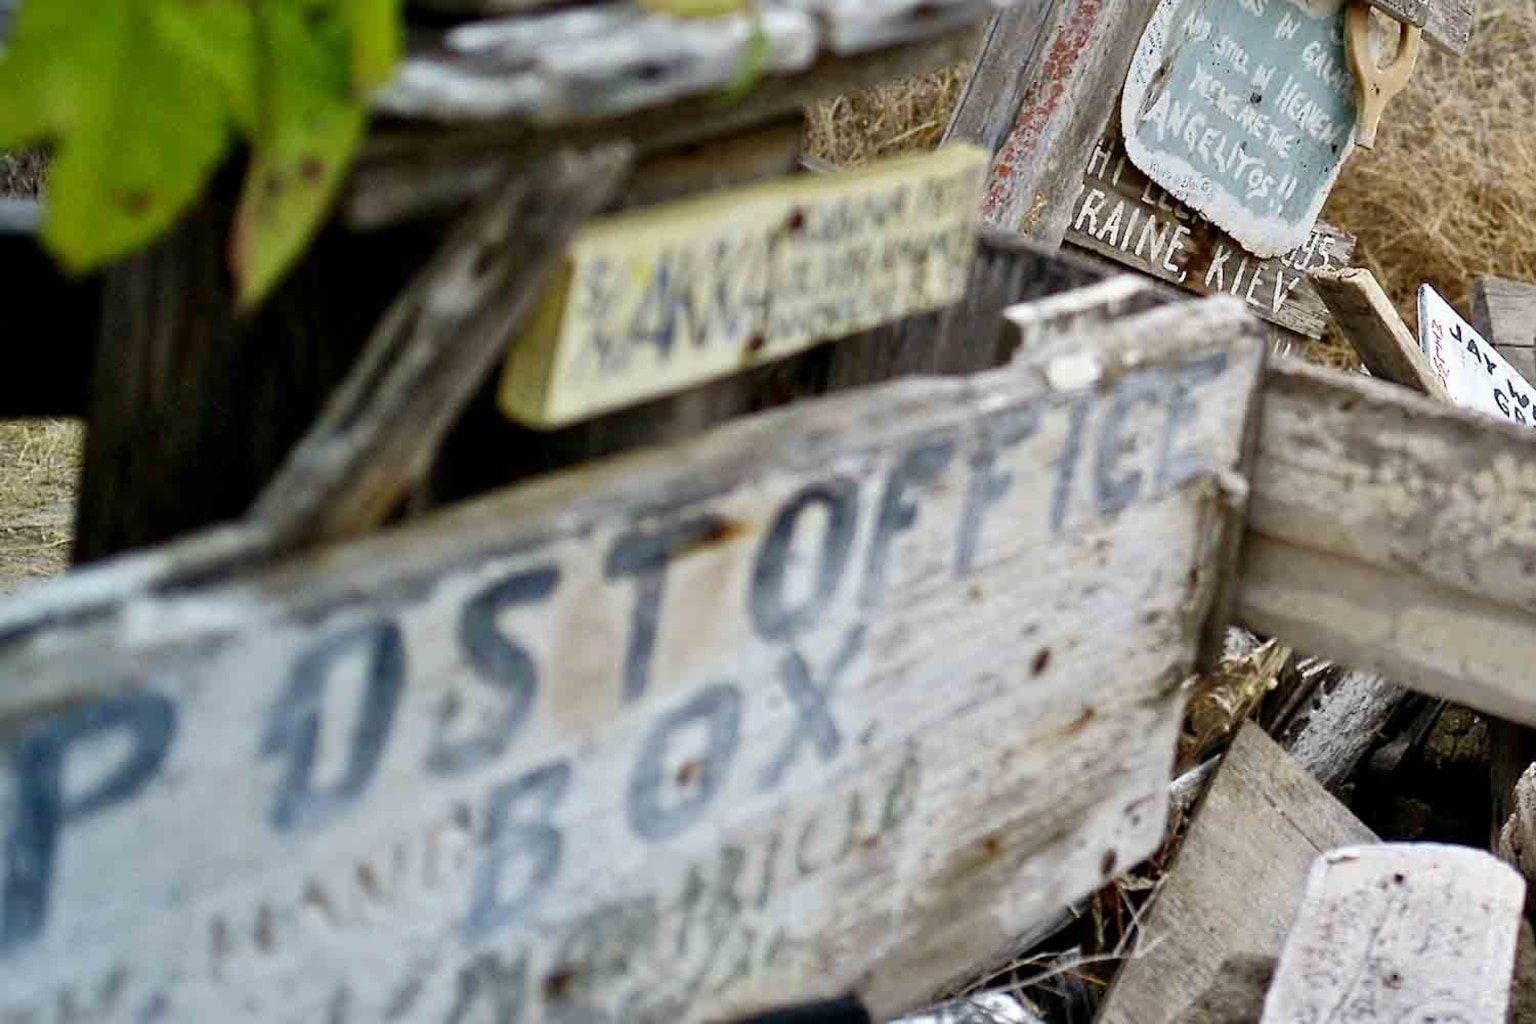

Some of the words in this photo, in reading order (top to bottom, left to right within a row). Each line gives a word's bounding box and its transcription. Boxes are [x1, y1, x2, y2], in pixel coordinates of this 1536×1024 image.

[1275, 12, 1300, 39] IN
[1070, 184, 1191, 282] RAINE,
[1204, 244, 1300, 314] KIEV
[1450, 324, 1497, 376] JAY
[744, 347, 1236, 644] OFFICE
[468, 619, 868, 936] BOX
